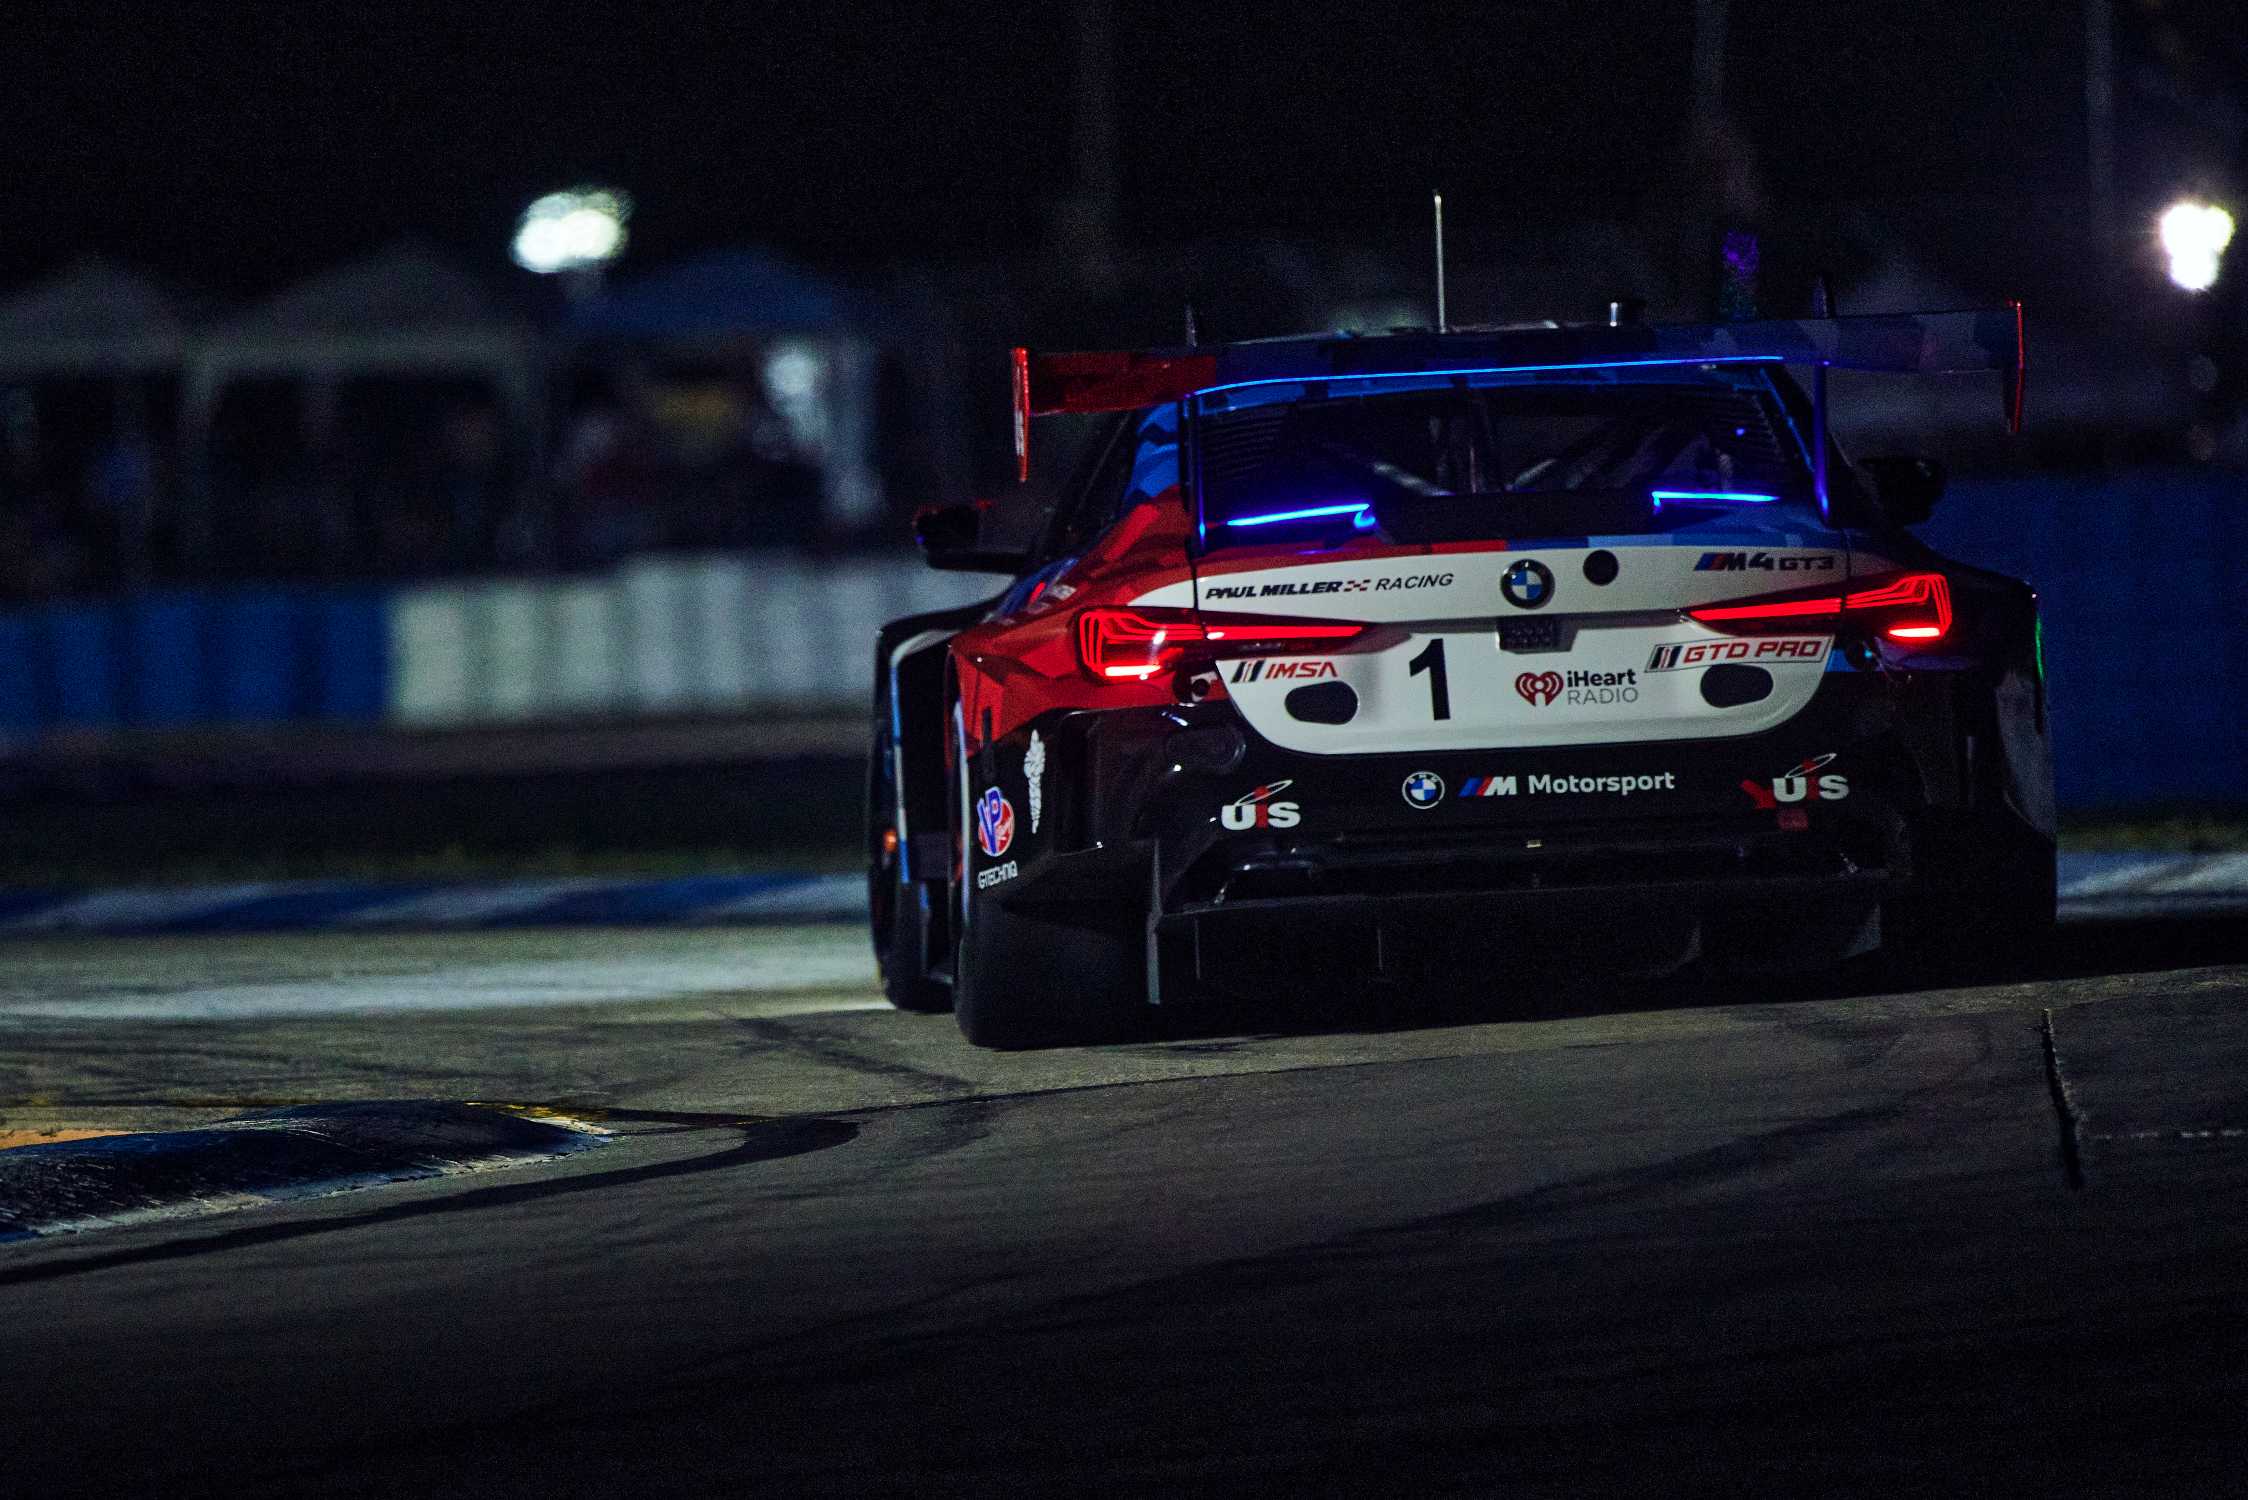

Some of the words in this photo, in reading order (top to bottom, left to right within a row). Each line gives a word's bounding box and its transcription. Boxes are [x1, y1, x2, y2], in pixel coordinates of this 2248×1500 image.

[1779, 556, 1834, 571] GT3
[1206, 584, 1257, 600] PAUL
[1260, 580, 1343, 597] MILLER
[1375, 573, 1454, 591] RACING
[1683, 642, 1751, 664] GTD
[1754, 641, 1822, 658] PRO
[1265, 661, 1339, 680] IMSA
[1409, 638, 1451, 721] 1
[1567, 669, 1637, 687] iHeart
[1567, 687, 1639, 705] RADIO
[1482, 775, 1519, 796] M
[1528, 771, 1676, 796] Motorsport
